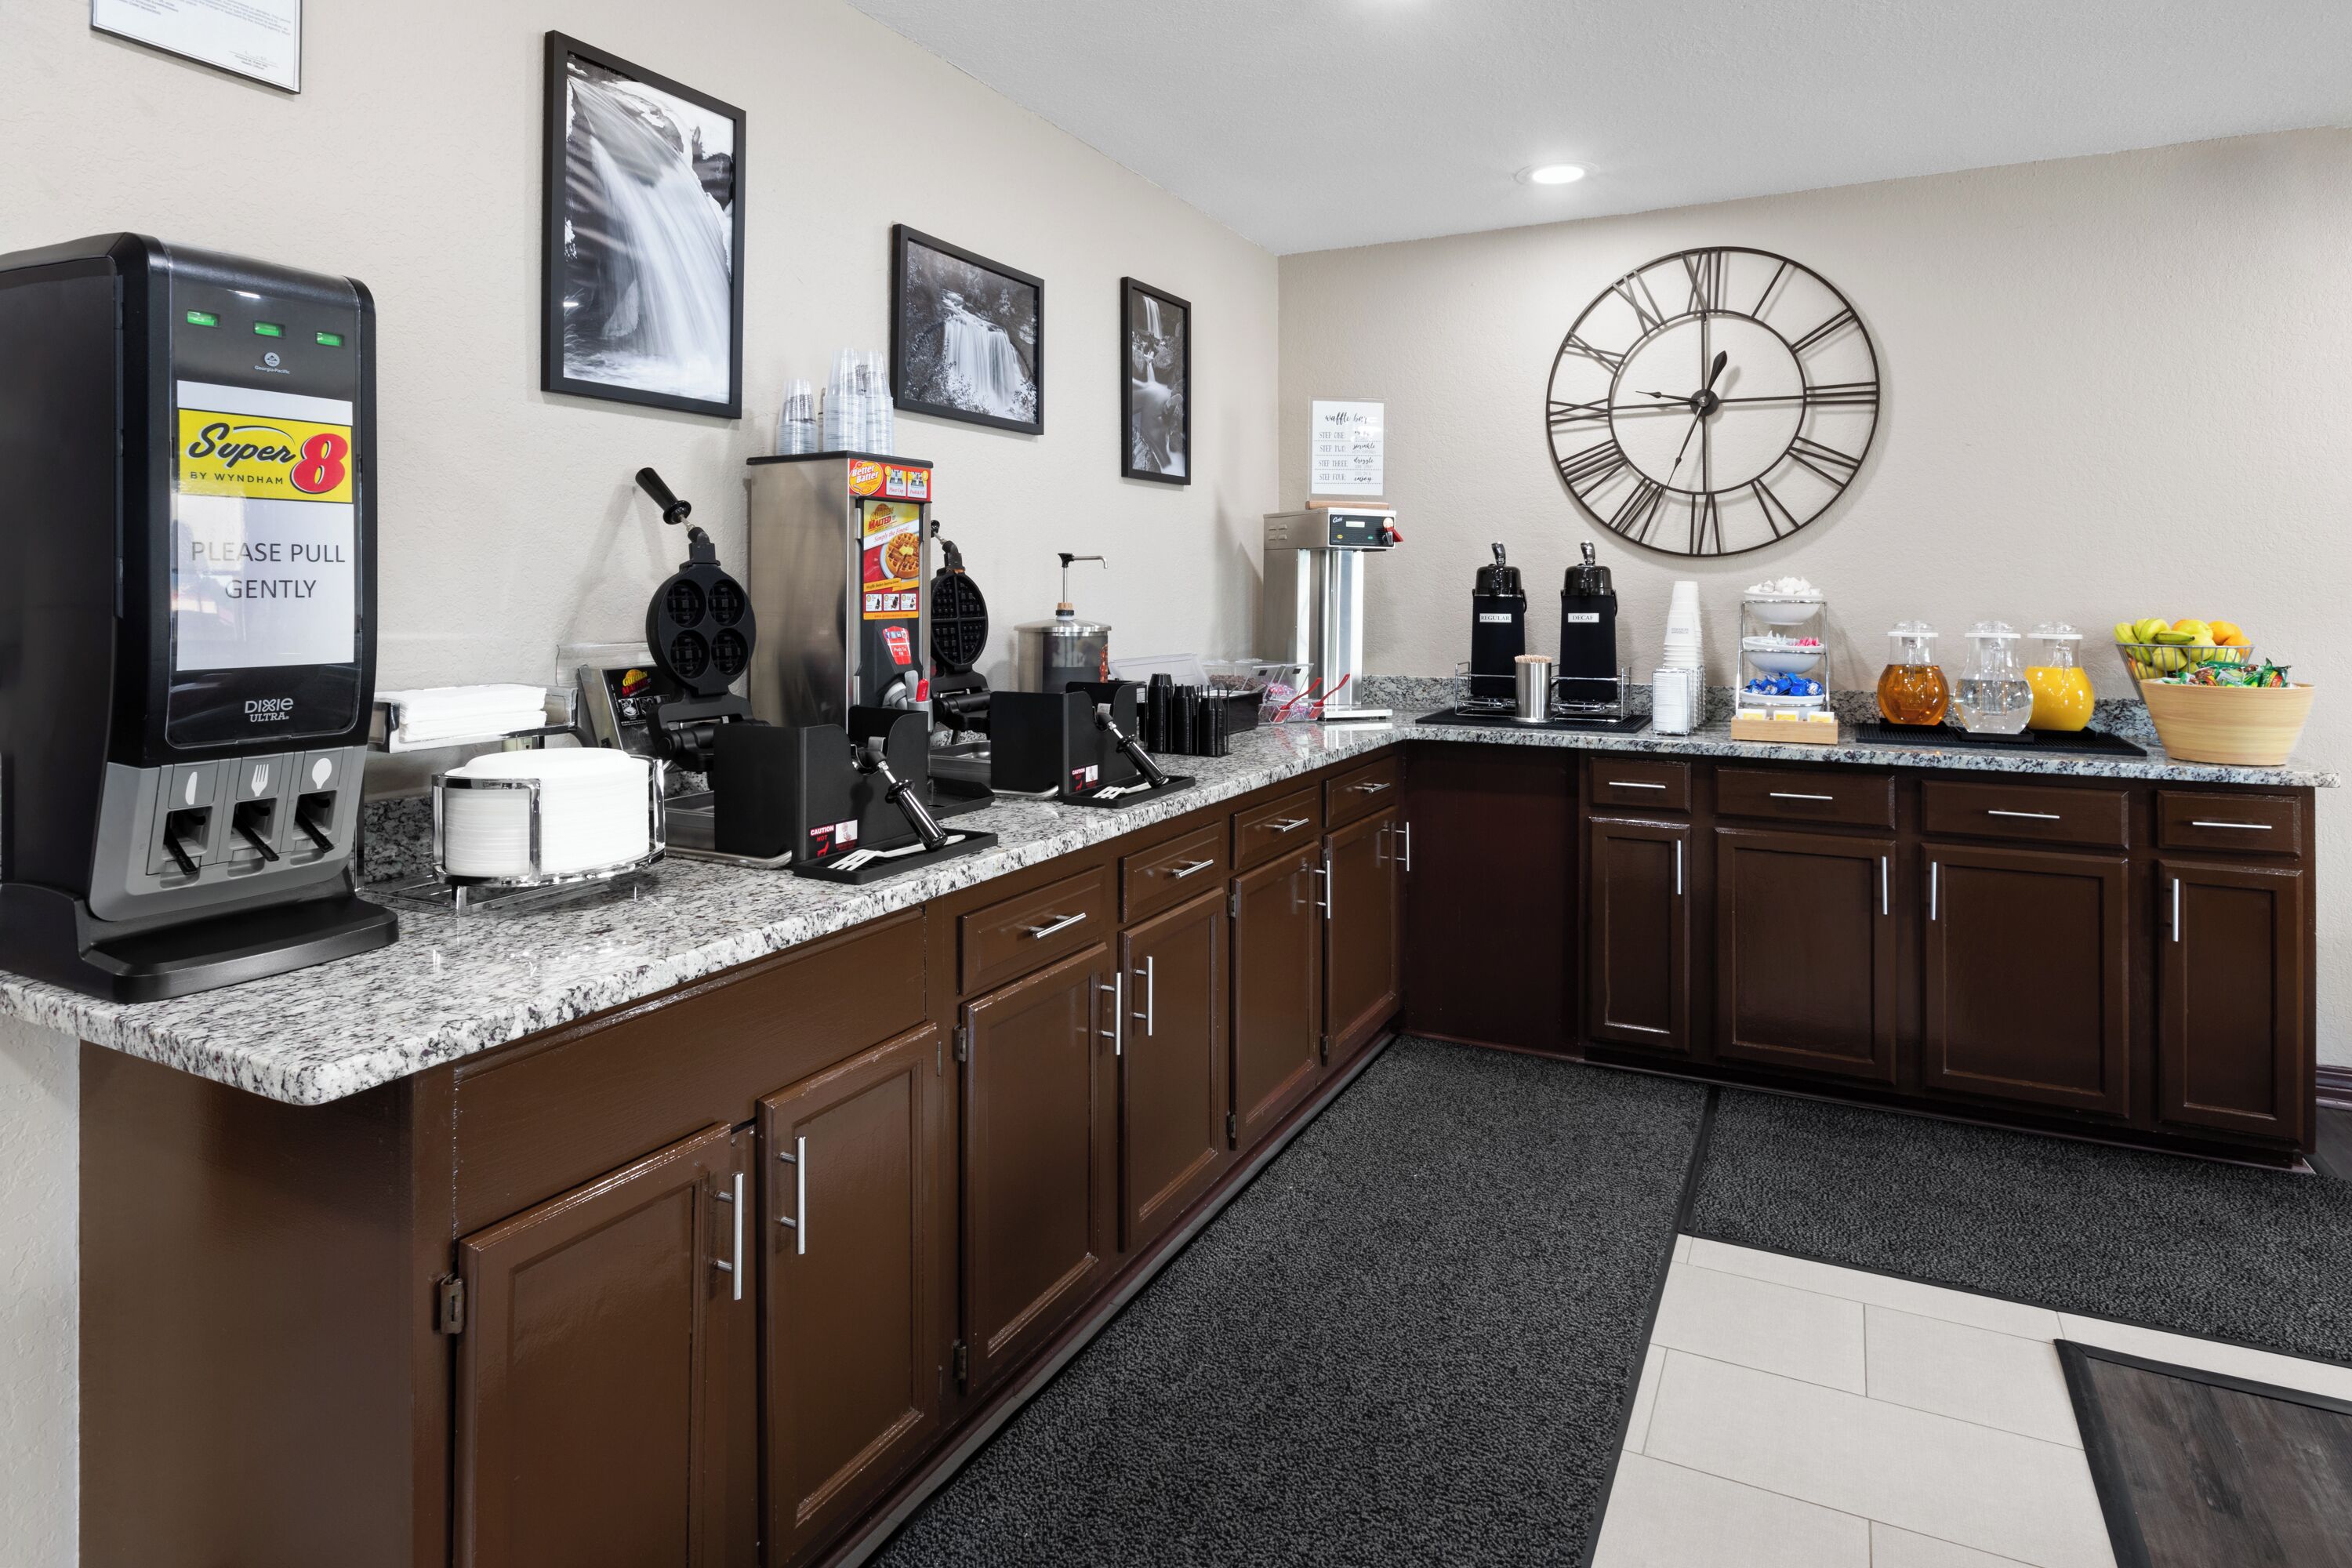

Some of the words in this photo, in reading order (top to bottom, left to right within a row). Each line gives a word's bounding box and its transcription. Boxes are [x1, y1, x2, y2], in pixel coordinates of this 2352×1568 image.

[254, 365, 290, 375] Georgia-Pacific
[1325, 412, 1349, 425] waffle
[187, 422, 297, 469] Super
[289, 433, 349, 495] 8
[851, 464, 876, 477] Better
[856, 470, 880, 484] Batter
[214, 473, 284, 485] WYNDHAM
[868, 515, 892, 531] MALTED
[191, 542, 281, 561] PLEASE
[291, 544, 345, 562] PULL
[225, 579, 317, 599] GENTLY
[810, 825, 834, 836] CAUTION
